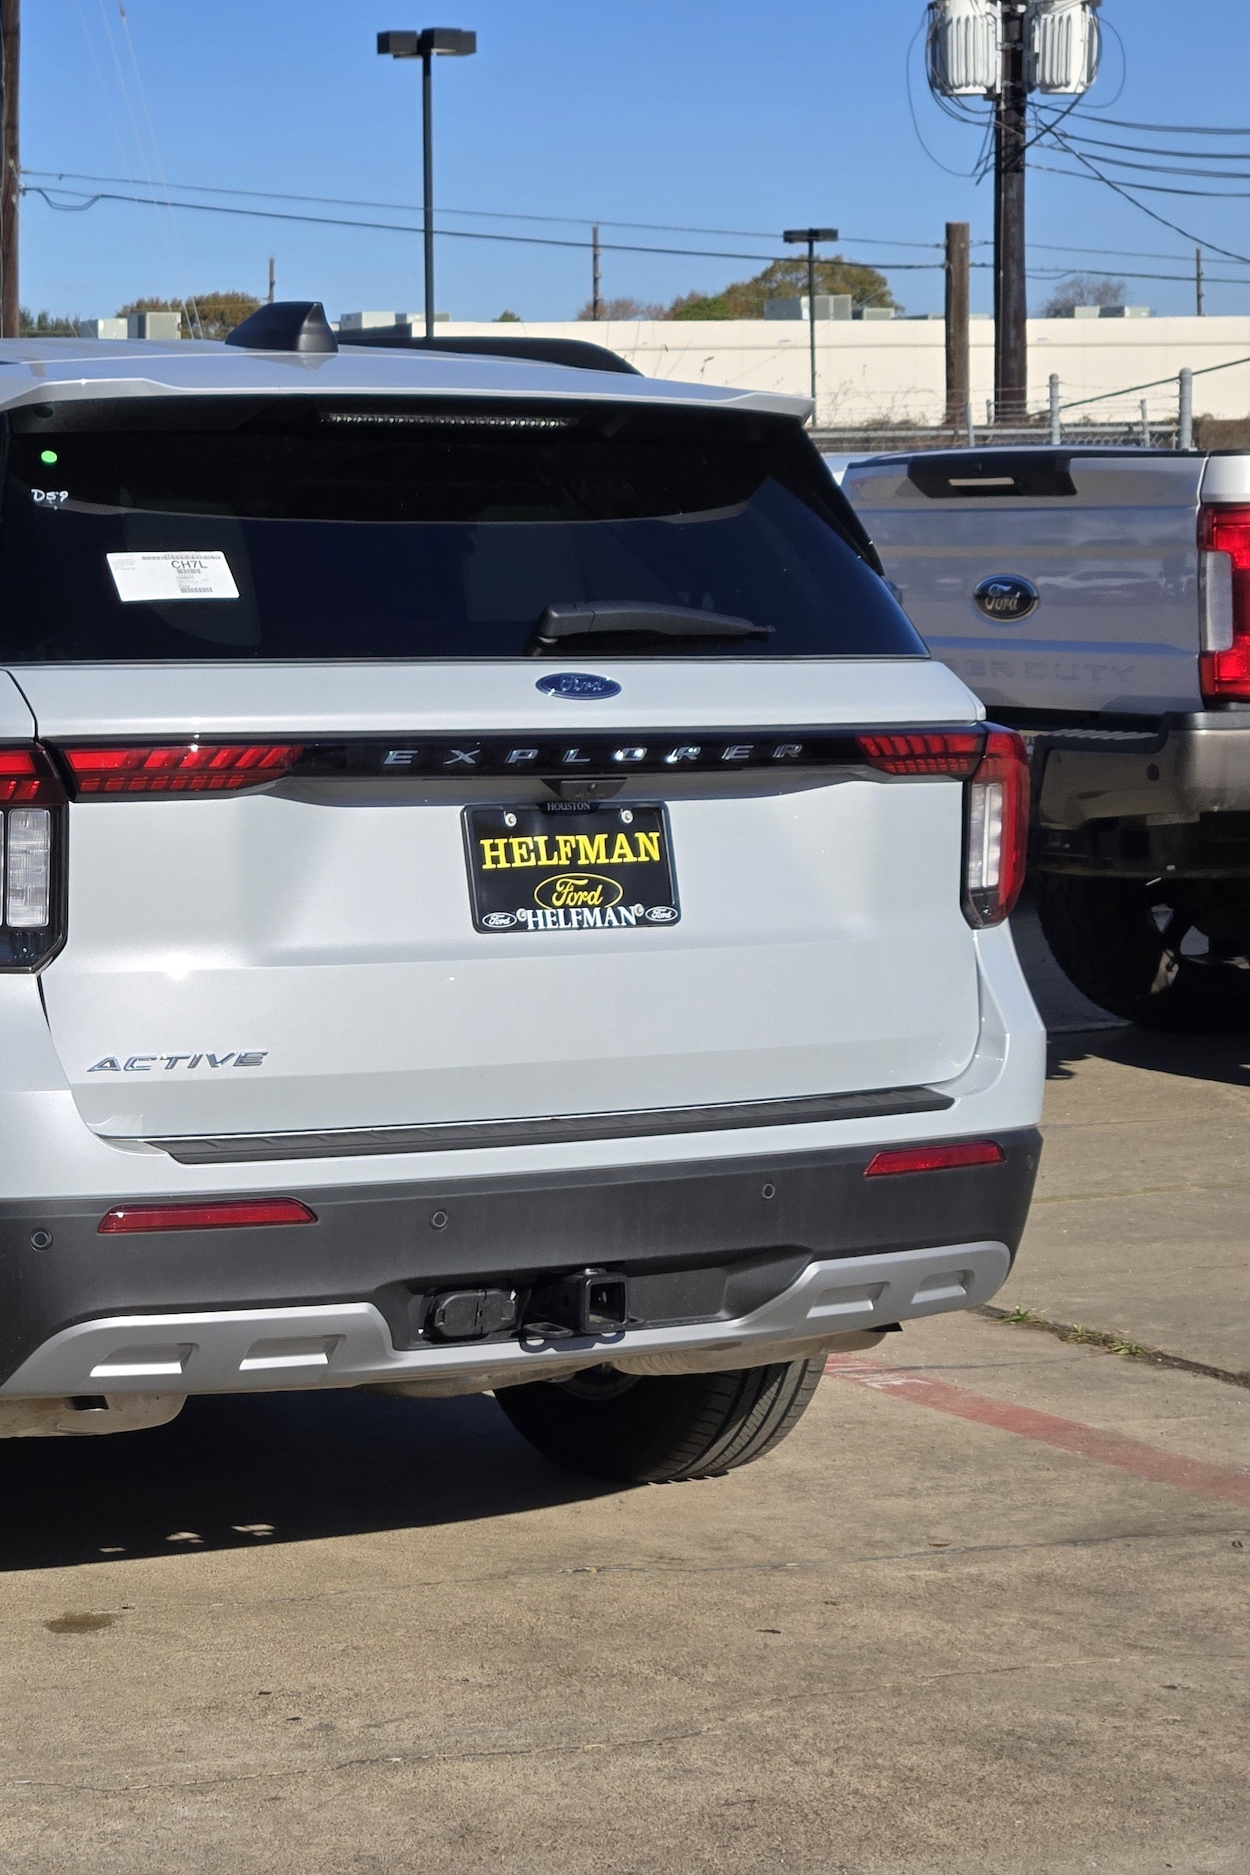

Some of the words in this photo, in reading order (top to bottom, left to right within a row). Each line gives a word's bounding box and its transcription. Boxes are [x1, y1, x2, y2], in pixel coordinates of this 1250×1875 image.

[171, 560, 208, 569] CH7L
[1024, 661, 1135, 682] DUTY
[383, 743, 803, 766] EXPLORER
[546, 801, 591, 811] HOUSTON
[479, 831, 661, 869] HELFMAN
[551, 878, 604, 907] Ford
[526, 905, 638, 930] HELFMAN
[86, 1051, 269, 1072] ACTIVE
